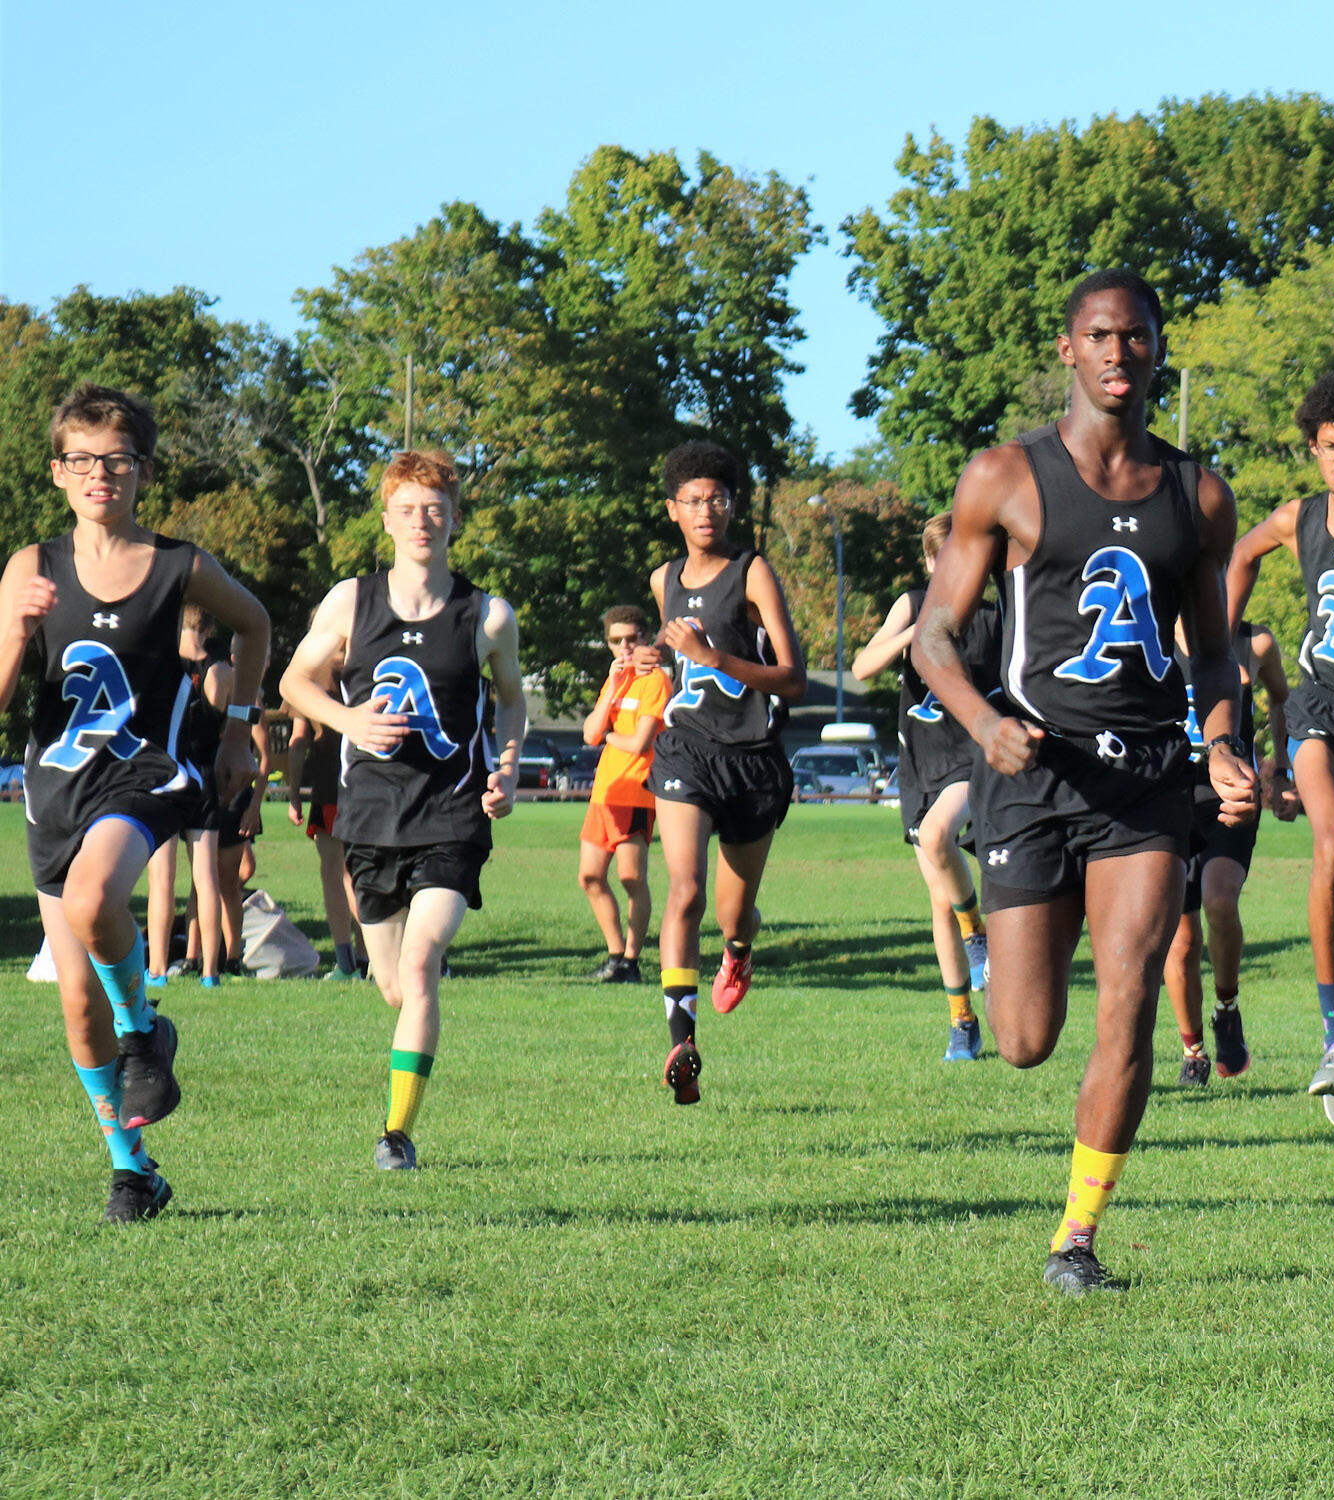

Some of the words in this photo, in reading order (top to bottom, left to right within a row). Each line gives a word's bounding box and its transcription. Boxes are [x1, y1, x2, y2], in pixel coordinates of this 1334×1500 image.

[1053, 545, 1172, 683] A
[39, 639, 148, 772] A
[356, 656, 460, 760] A
